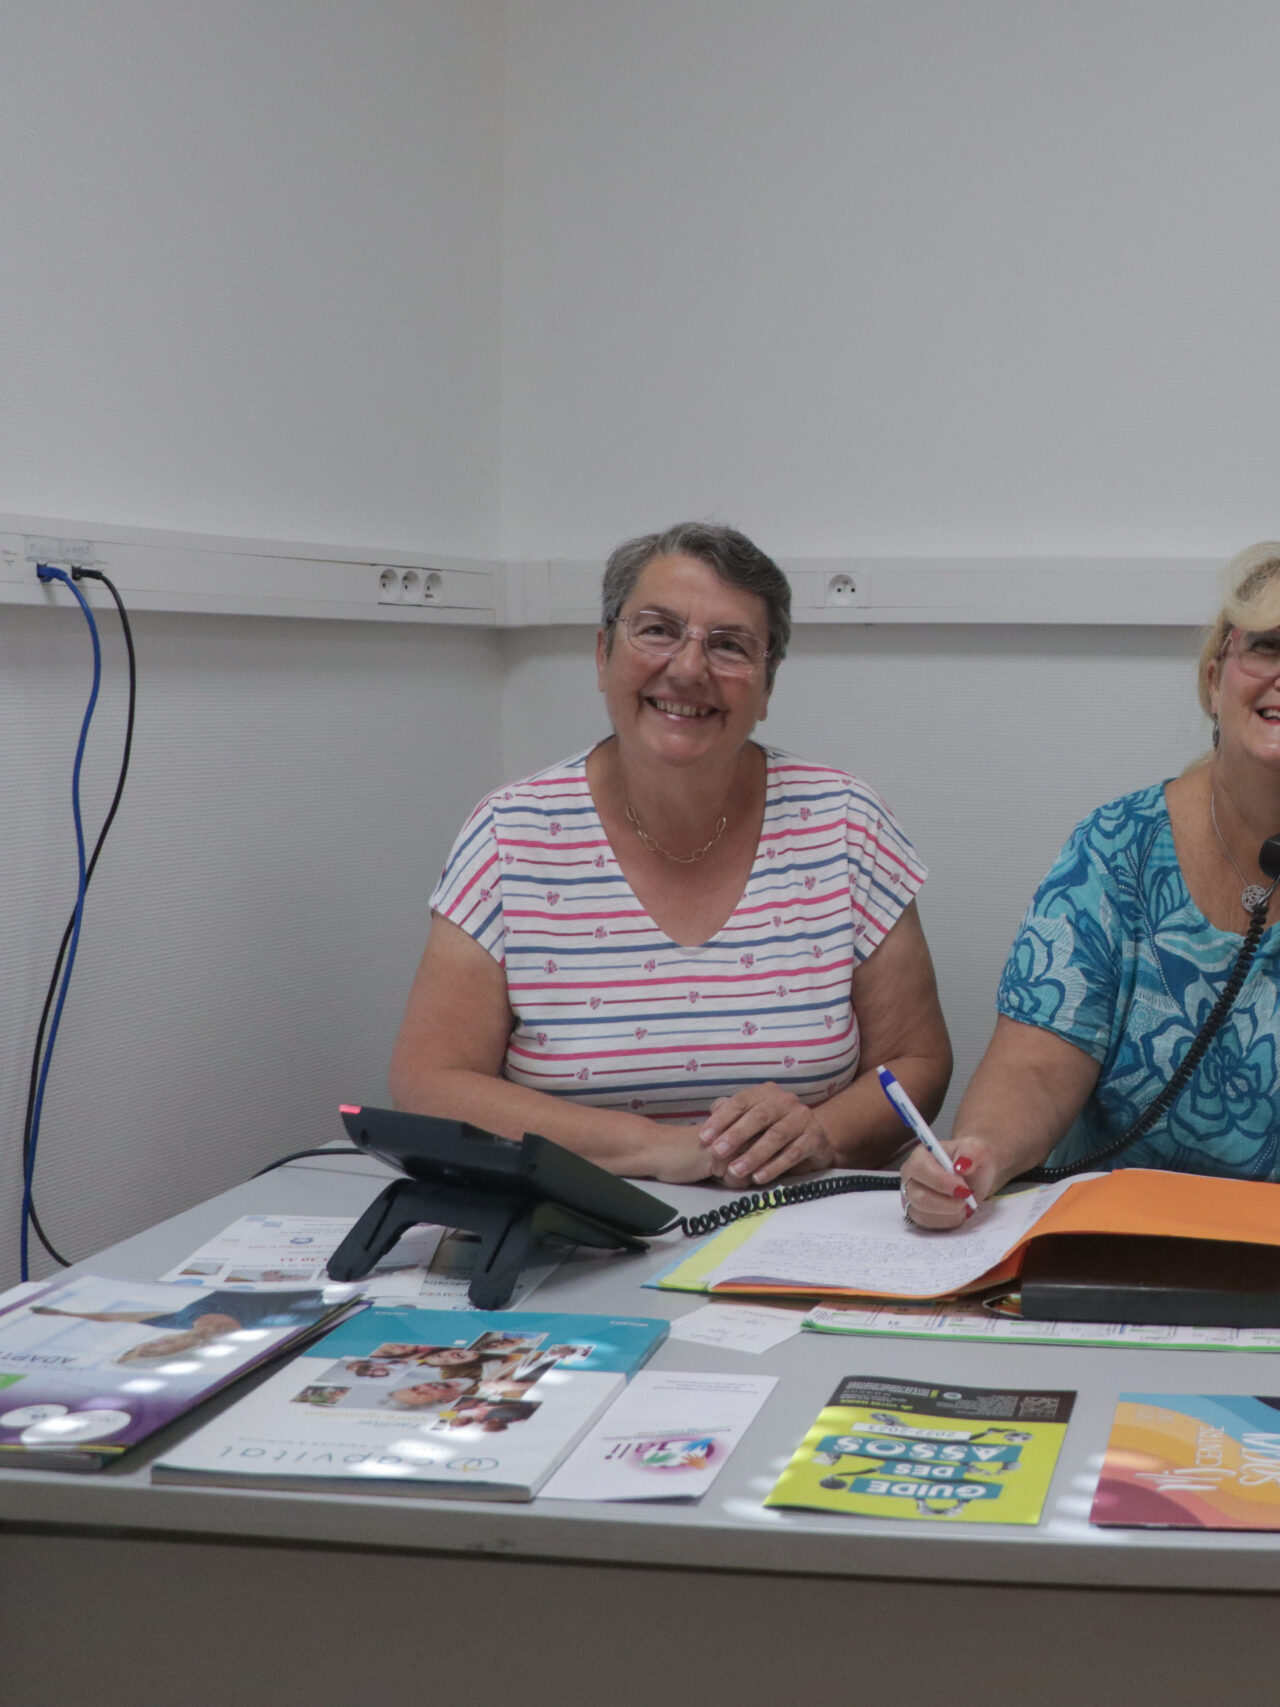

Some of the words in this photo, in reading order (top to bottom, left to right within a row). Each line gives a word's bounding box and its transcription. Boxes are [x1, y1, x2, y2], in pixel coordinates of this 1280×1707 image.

[0, 1351, 79, 1366] ADAPT
[866, 1424, 958, 1439] 2022-2023
[833, 1437, 1008, 1462] ASSOS
[1195, 1424, 1226, 1467] CENTRE
[893, 1463, 956, 1477] DES
[866, 1480, 987, 1498] GUIDE
